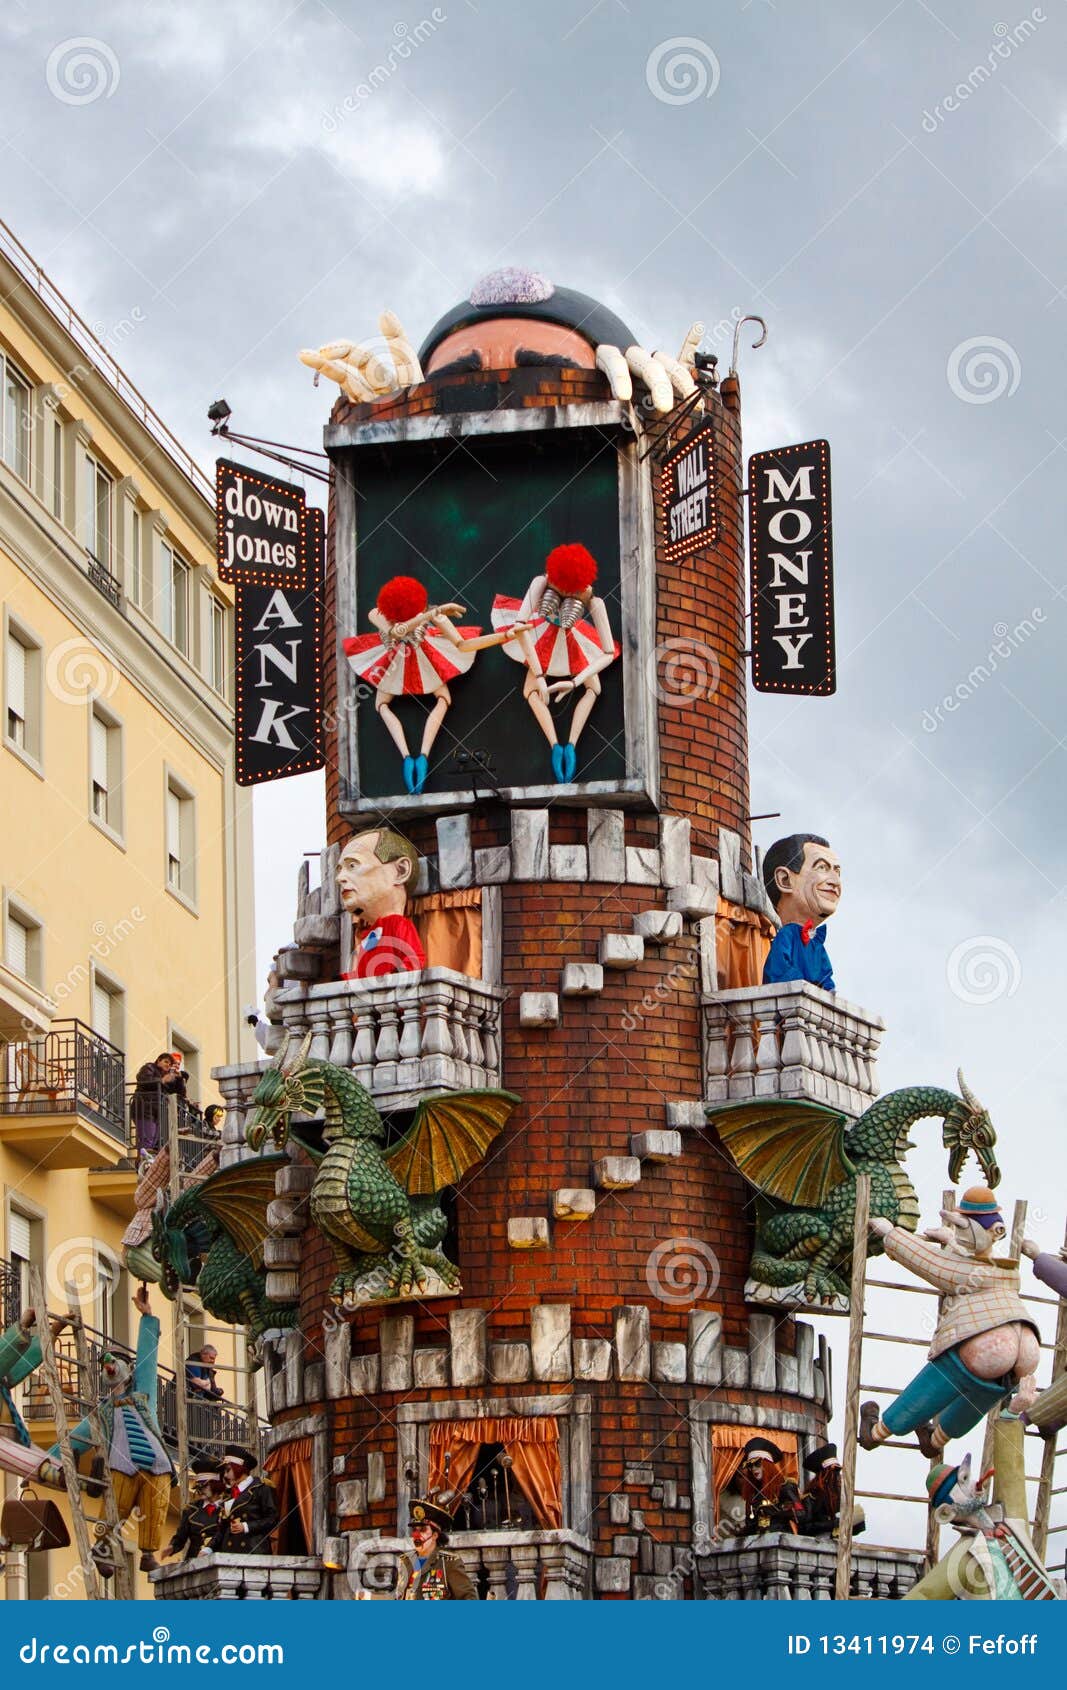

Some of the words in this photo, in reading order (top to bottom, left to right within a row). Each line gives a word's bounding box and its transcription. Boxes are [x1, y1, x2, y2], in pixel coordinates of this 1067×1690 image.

[677, 444, 708, 498] WALL
[225, 477, 299, 533] down
[670, 490, 708, 542] STREET
[223, 519, 297, 569] jones
[763, 466, 816, 670] MONEY
[248, 588, 310, 751] ANK
